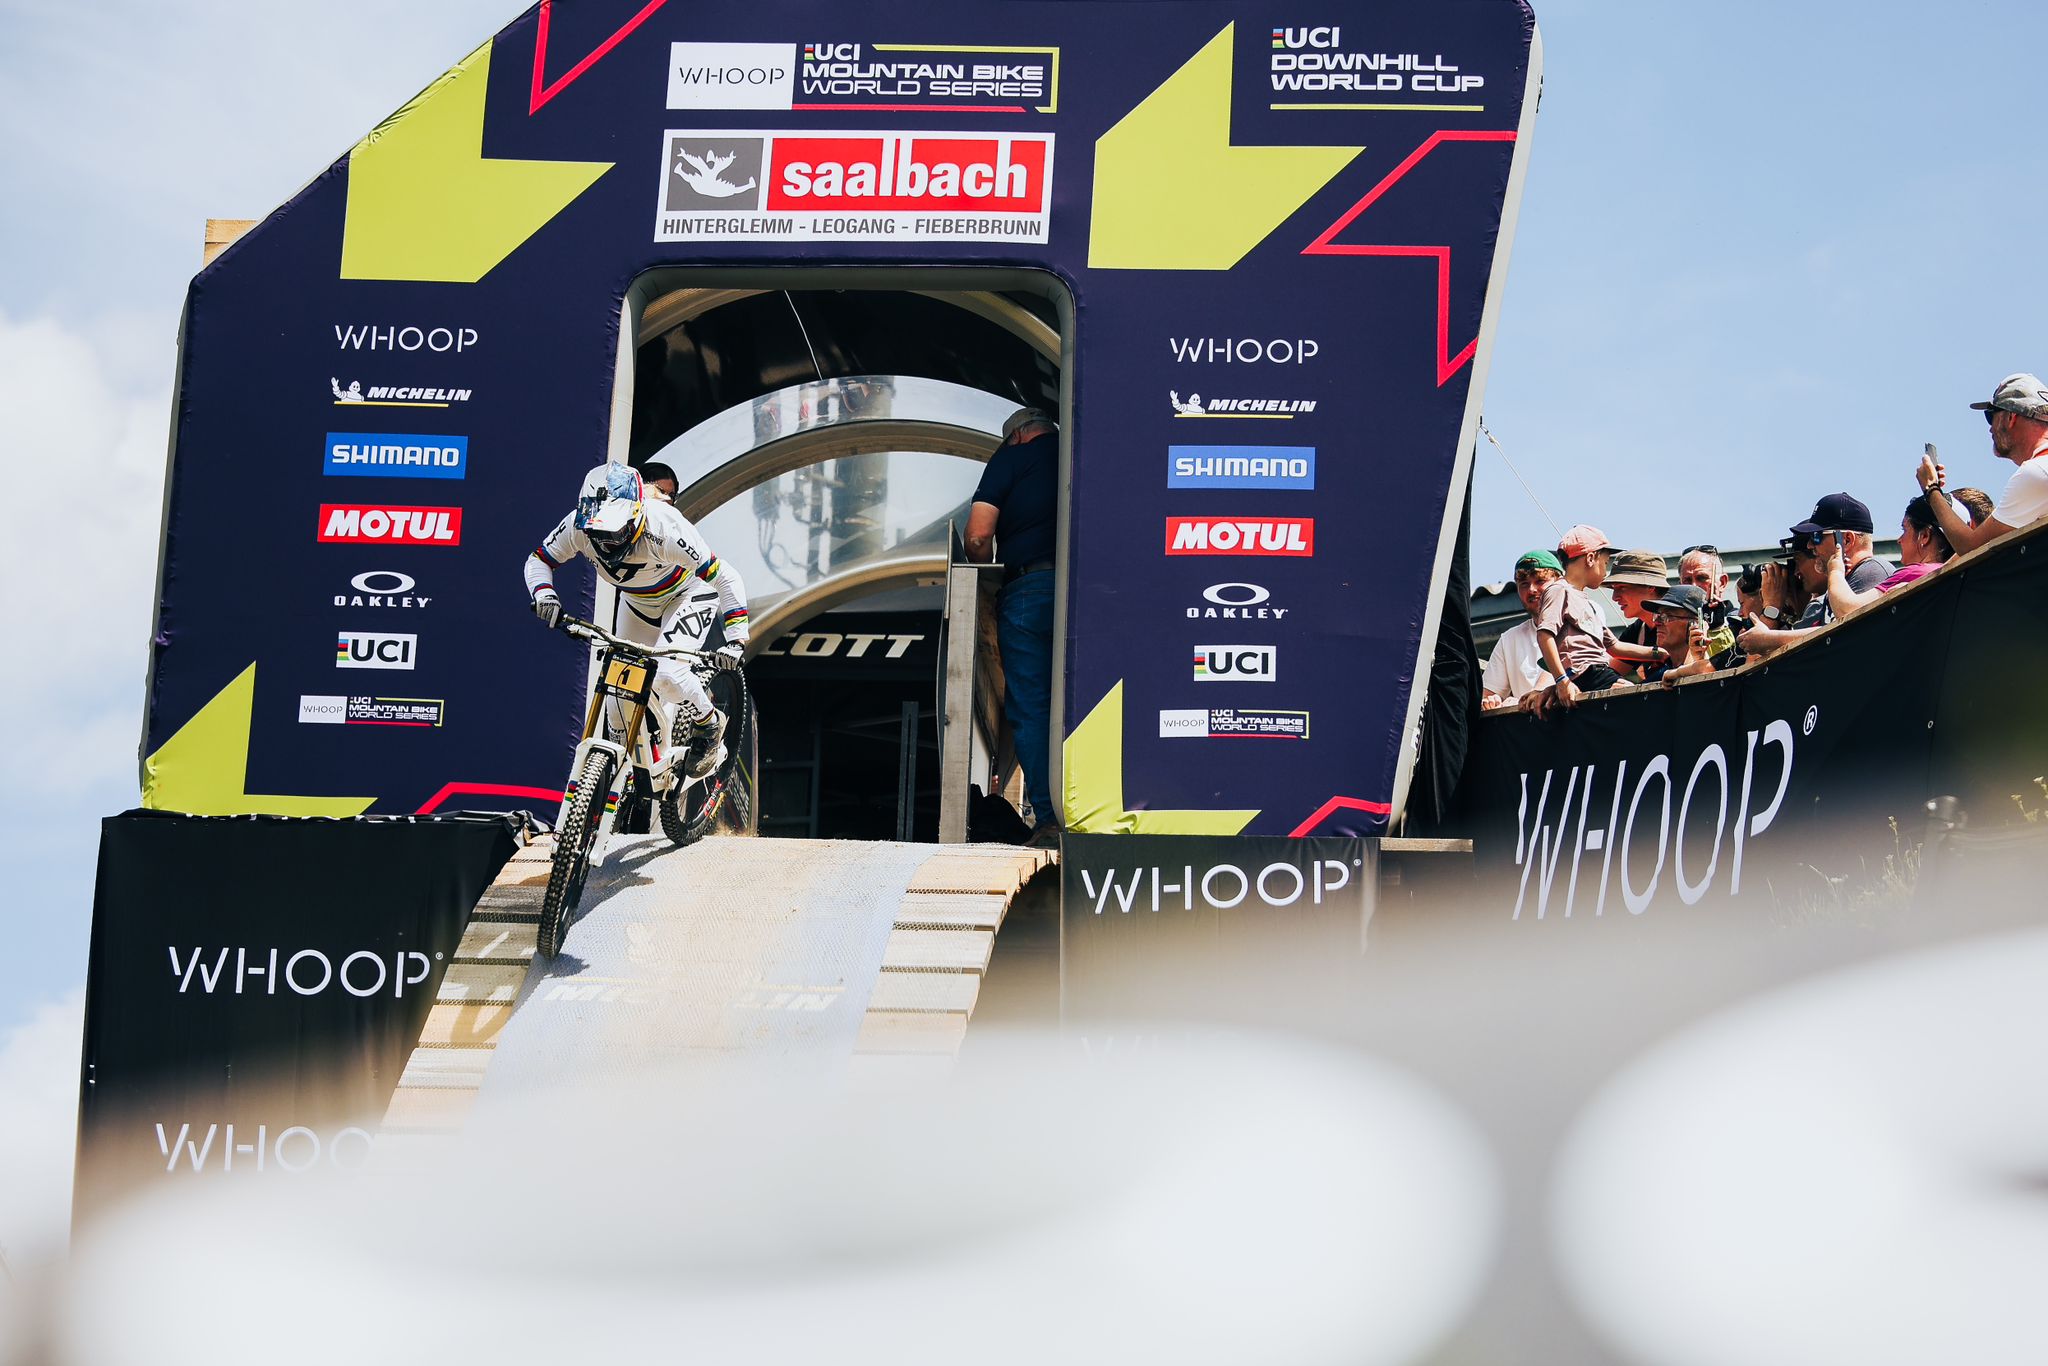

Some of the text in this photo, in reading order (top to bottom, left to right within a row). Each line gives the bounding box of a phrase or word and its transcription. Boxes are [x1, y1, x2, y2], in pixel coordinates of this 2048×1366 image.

[1284, 26, 1340, 49] UCI
[814, 43, 860, 61] UCI
[1271, 53, 1459, 72] DOWNHILL
[679, 66, 785, 86] WHOOP
[802, 63, 1044, 81] MOUNTAIN BIKE
[802, 79, 1043, 97] WORLD SERIES
[1270, 73, 1485, 92] WORLD CUP
[782, 138, 1027, 198] saalbach
[662, 218, 793, 235] HINTERGLEMM
[811, 218, 896, 235] LEOGANG
[914, 219, 1042, 236] FIEBERBRUNN
[334, 325, 479, 352] WHOOP
[1169, 337, 1319, 364] WHOOP
[367, 386, 472, 401] MICHELIN
[1207, 398, 1317, 412] MICHELIN
[331, 444, 460, 467] SHIMANO
[1175, 457, 1308, 478] SHIMANO
[323, 509, 454, 540] MOTUL
[1171, 521, 1307, 551] MOTUL
[333, 595, 430, 608] OAKLEY
[1186, 607, 1286, 619] OAKLEY
[350, 638, 411, 663] UCI
[760, 632, 925, 659] COTT
[1207, 651, 1270, 675] UCI
[621, 669, 631, 685] 1
[303, 705, 343, 714] WHOOP
[348, 704, 438, 714] MOUNTAIN BIKE
[353, 696, 371, 705] UCI
[348, 711, 437, 720] WORLD SERIES
[1210, 717, 1304, 726] MOUNTAIN BIKE
[1215, 709, 1233, 717] UCI
[1163, 719, 1205, 728] WHOOP
